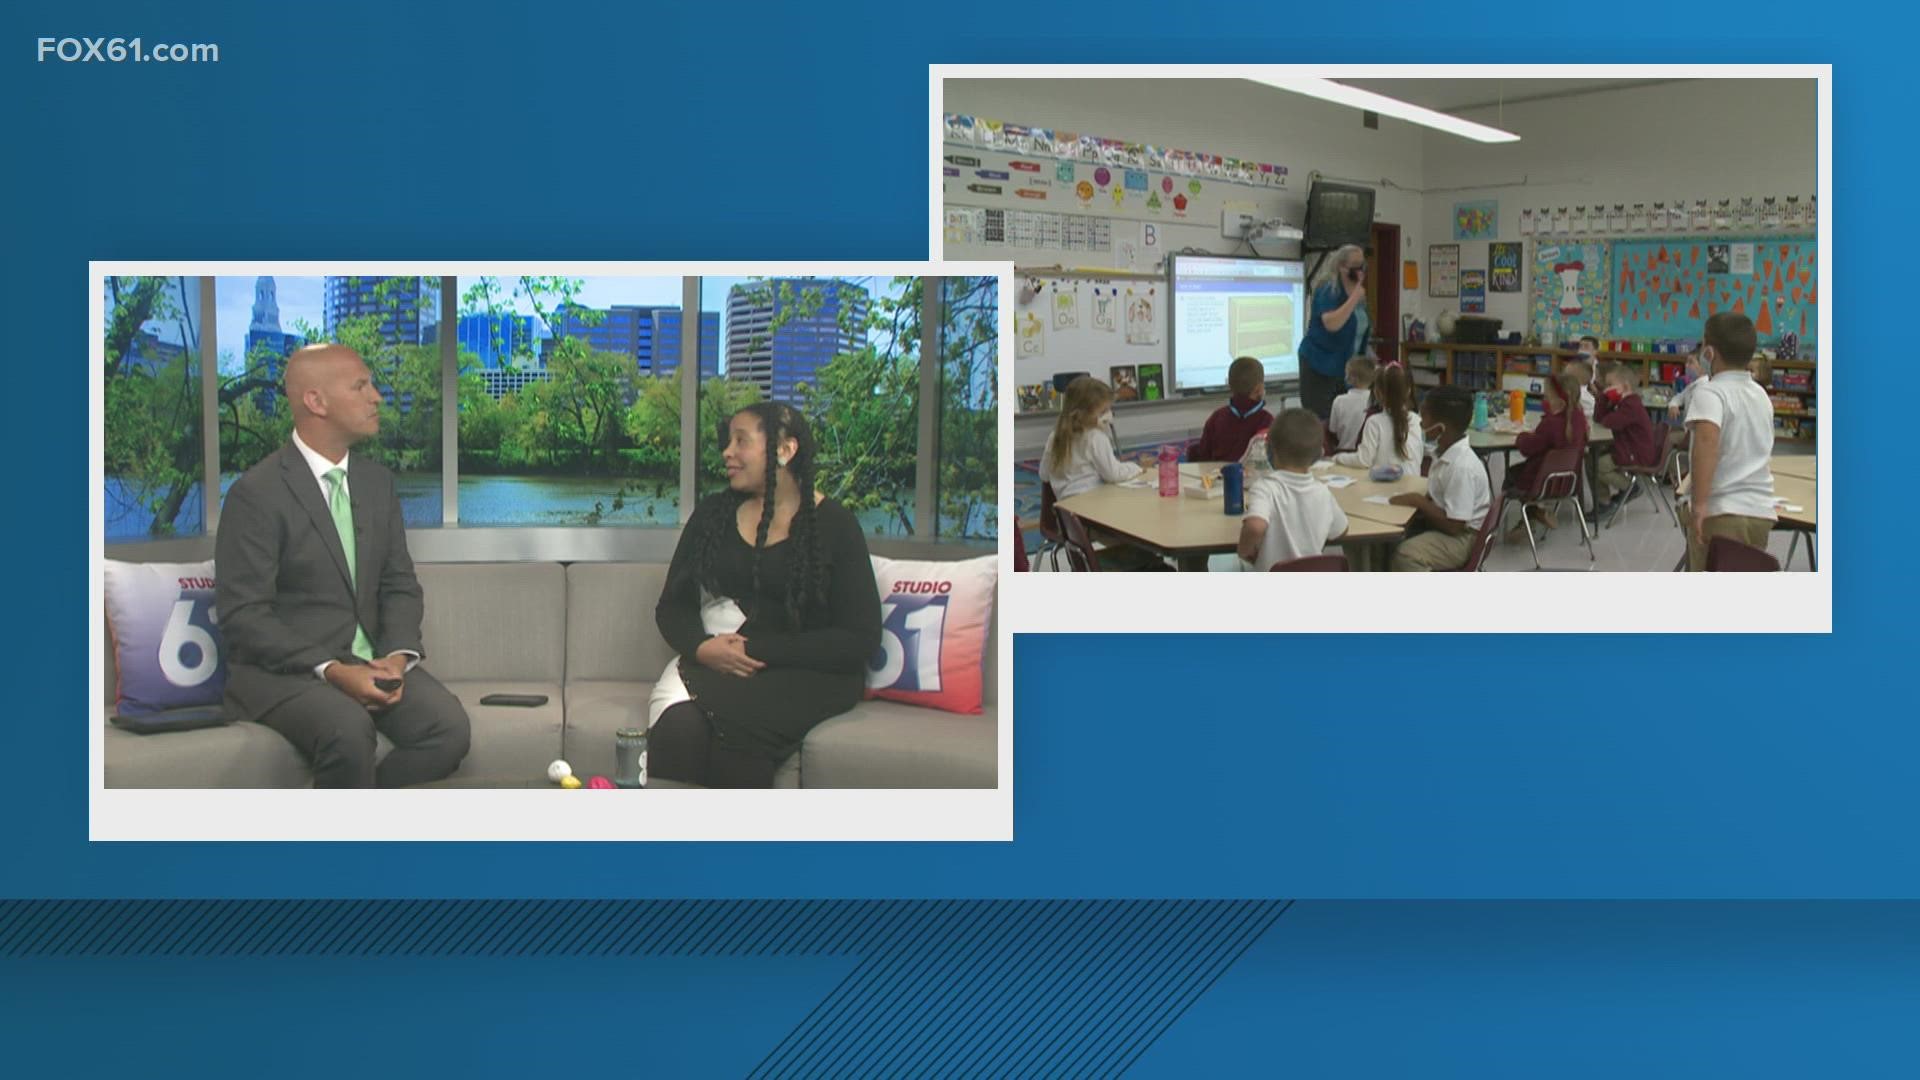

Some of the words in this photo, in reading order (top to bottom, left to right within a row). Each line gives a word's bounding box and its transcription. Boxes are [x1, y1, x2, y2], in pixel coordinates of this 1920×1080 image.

[1144, 224, 1156, 246] B
[1058, 312, 1075, 325] Oo
[892, 581, 953, 594] STUDIO
[159, 600, 218, 687] 6
